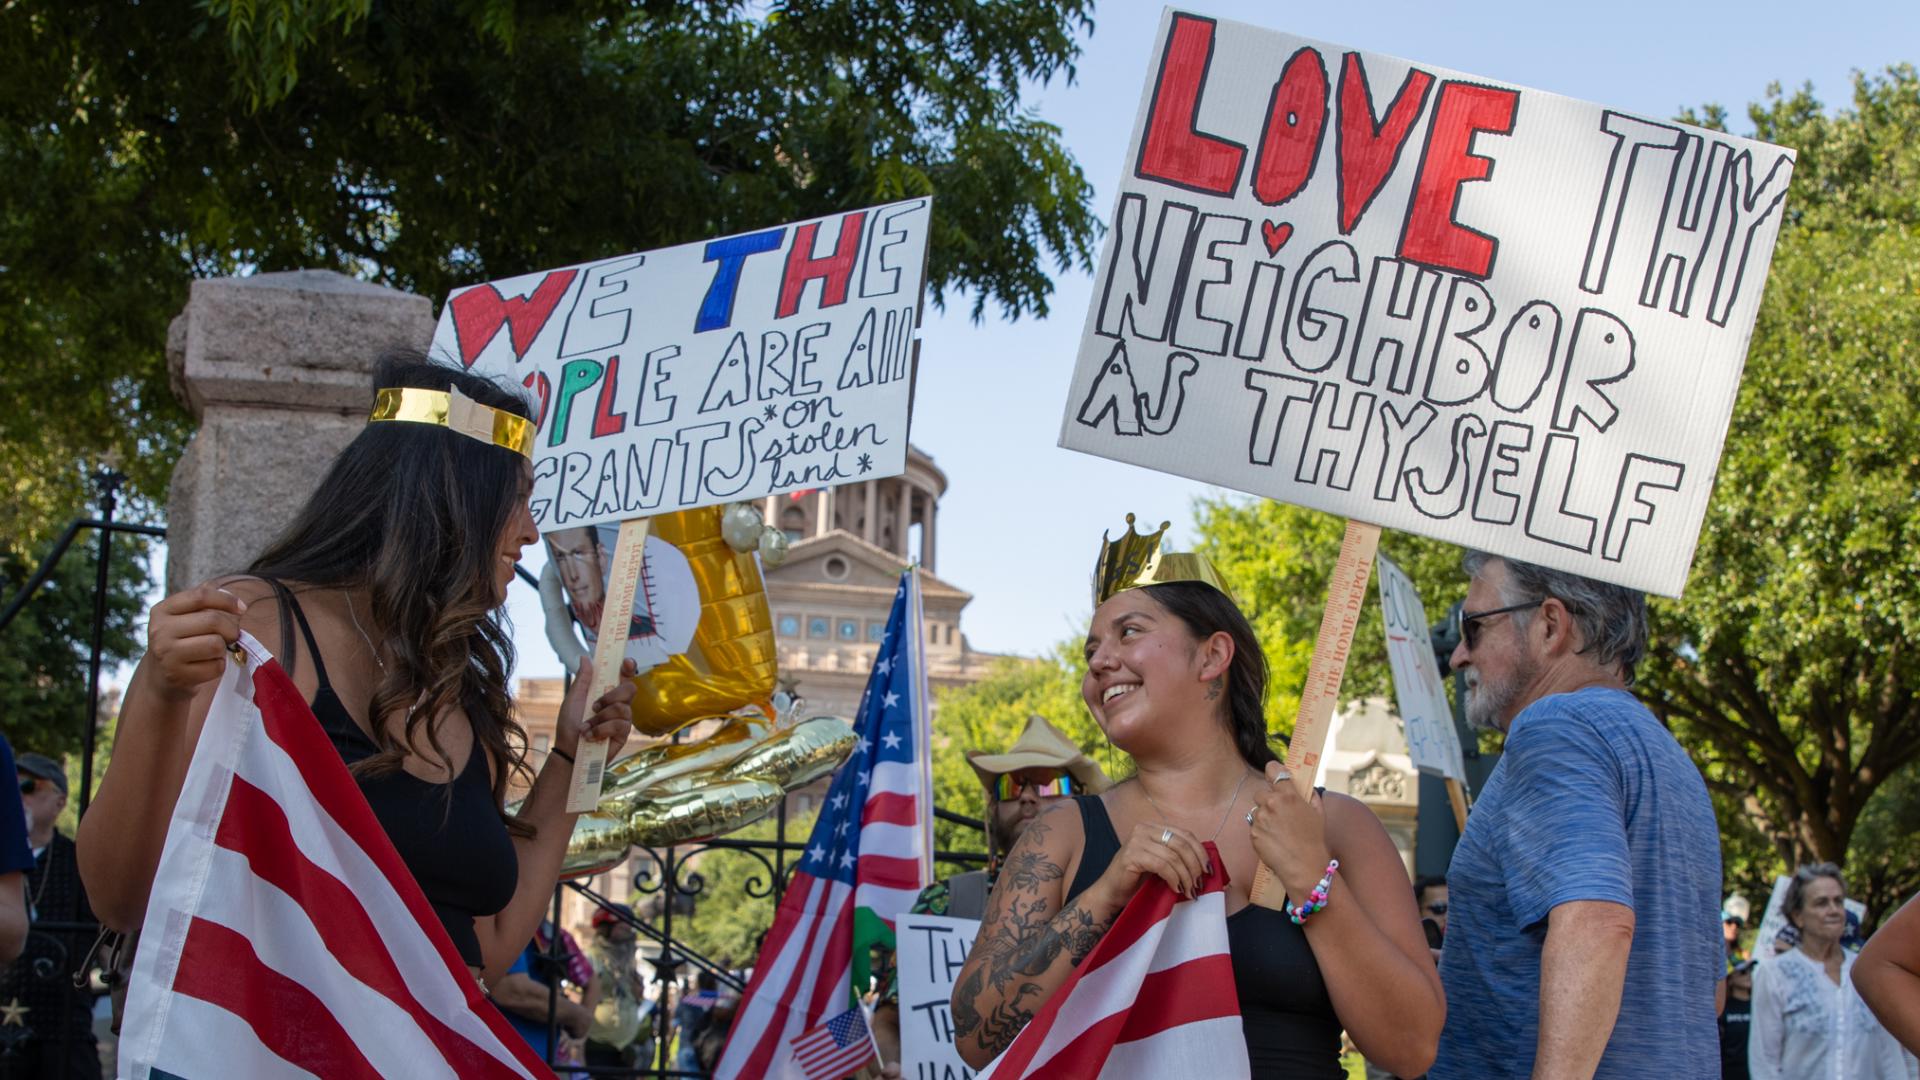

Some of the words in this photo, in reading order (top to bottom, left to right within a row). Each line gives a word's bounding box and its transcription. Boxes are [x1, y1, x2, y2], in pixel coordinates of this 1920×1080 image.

[1134, 11, 1521, 281] LOVE
[1579, 110, 1796, 328] THY
[449, 255, 646, 369] WE
[694, 199, 926, 334] THE
[1095, 192, 1636, 433] NEIGHBOR
[698, 322, 831, 414] ARE
[1076, 338, 1199, 436] AS
[760, 421, 888, 463] stolen
[1246, 368, 1685, 562] THYSELF
[1323, 665, 1341, 698] THE
[1333, 613, 1356, 663] HOME
[1346, 557, 1370, 612] DEPOT
[908, 925, 974, 983] TH
